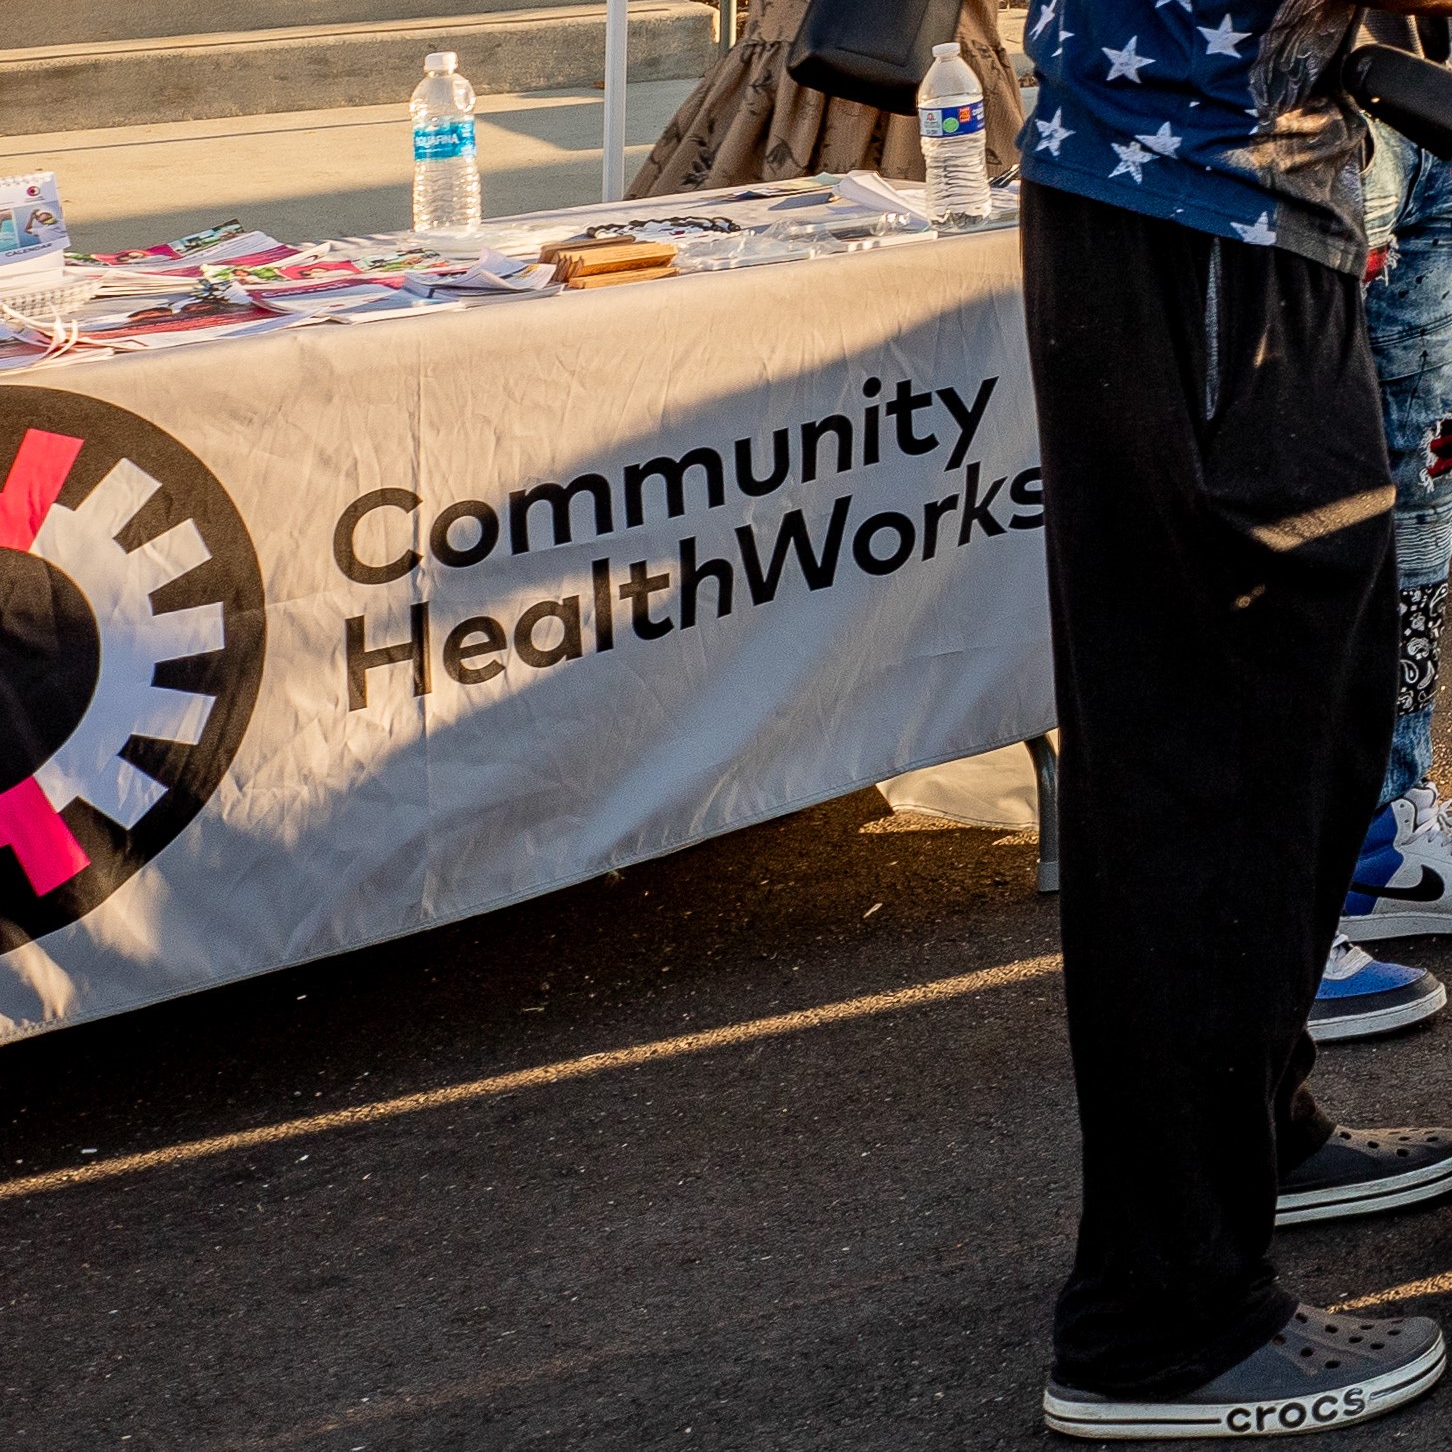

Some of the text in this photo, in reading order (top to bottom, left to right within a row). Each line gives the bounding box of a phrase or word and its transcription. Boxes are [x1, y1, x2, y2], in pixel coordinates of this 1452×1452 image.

[333, 376, 999, 585] Community
[344, 461, 1045, 712] HealthWorks
[1226, 1387, 1366, 1432] crocs
